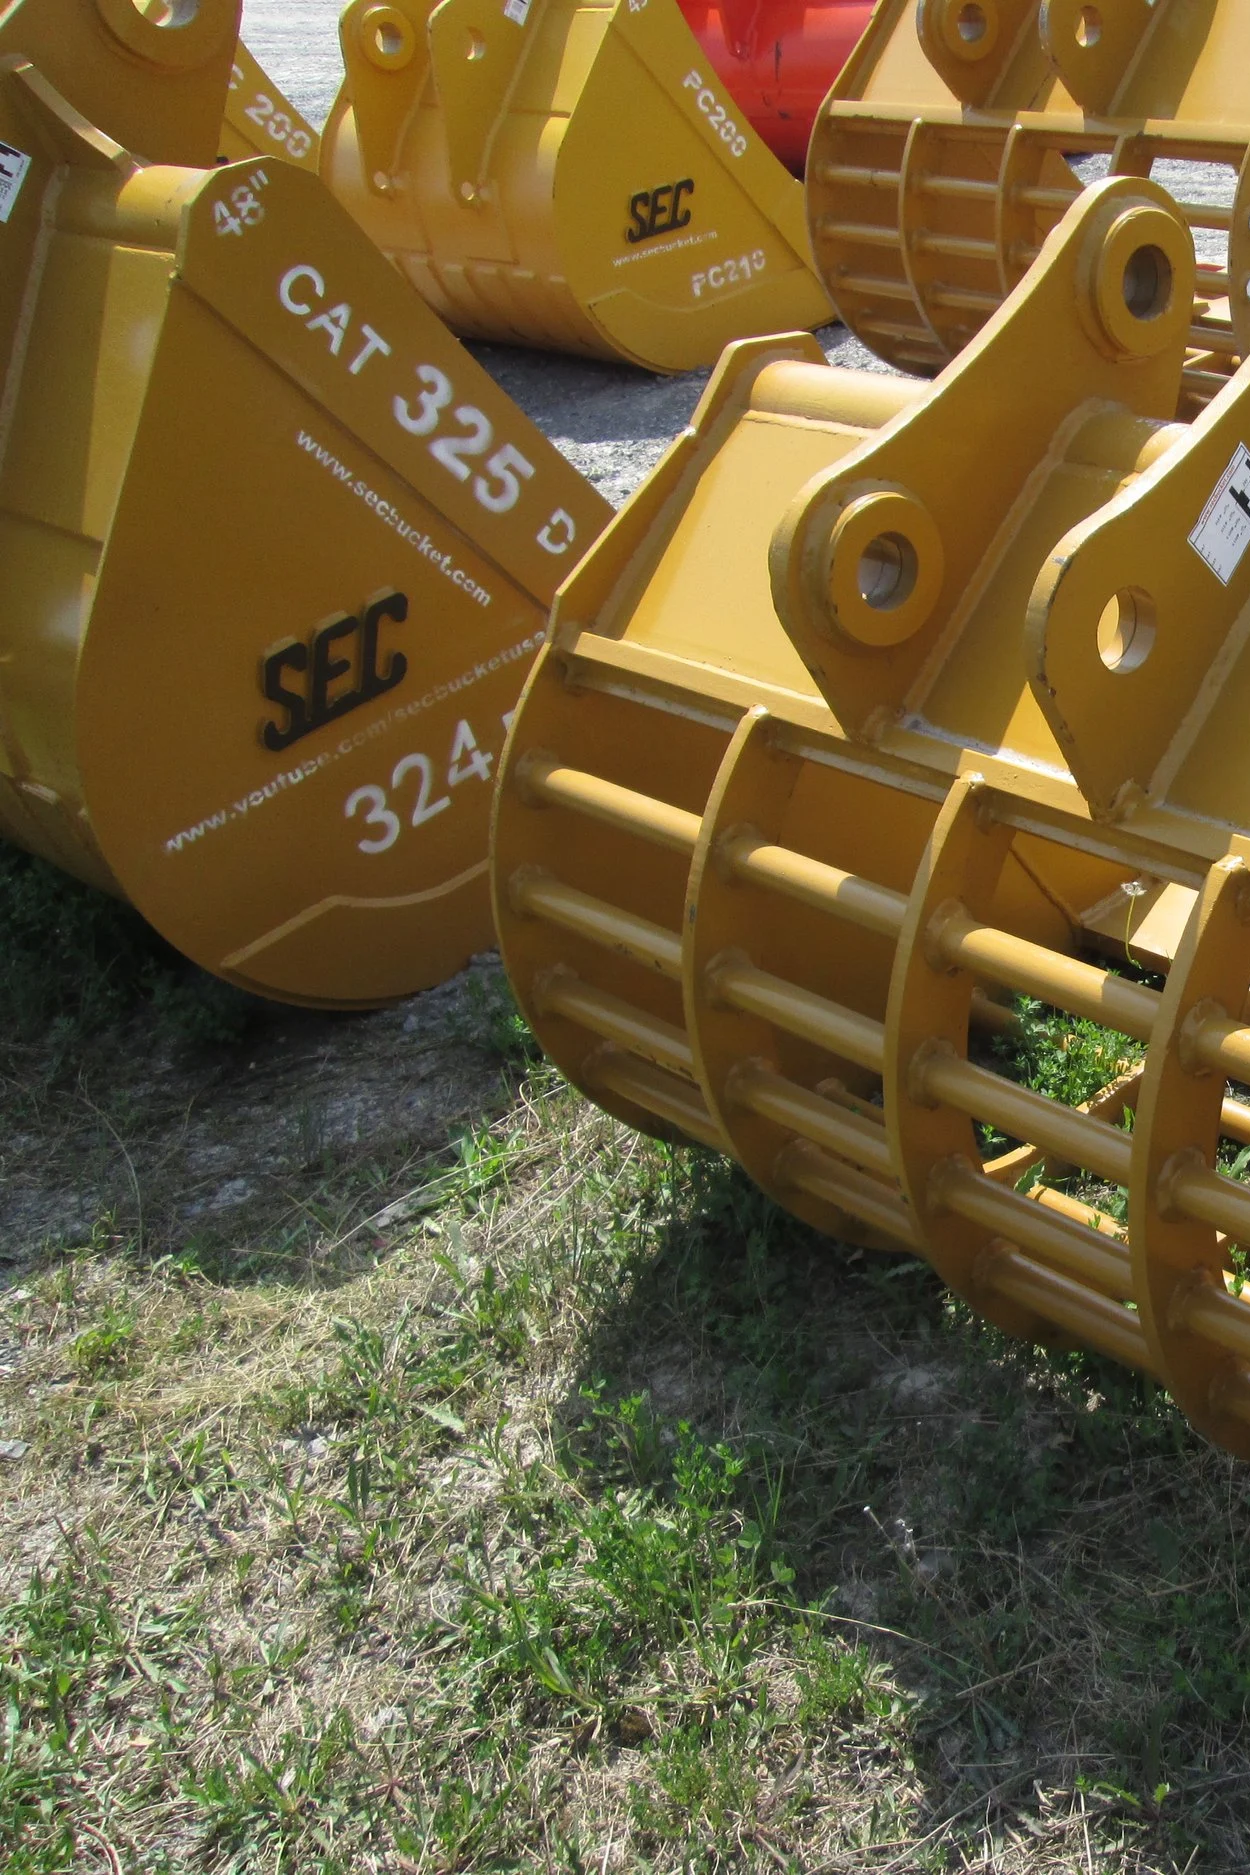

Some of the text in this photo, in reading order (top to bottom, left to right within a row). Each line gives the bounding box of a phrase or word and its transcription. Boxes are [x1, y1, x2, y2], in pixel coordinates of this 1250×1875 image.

[244, 93, 311, 158] 200
[627, 178, 694, 243] SEC
[279, 264, 392, 375] CAT
[394, 364, 536, 513] 325
[296, 430, 491, 607] www.secbucket.com
[260, 590, 408, 752] SEC
[345, 719, 493, 854] 324
